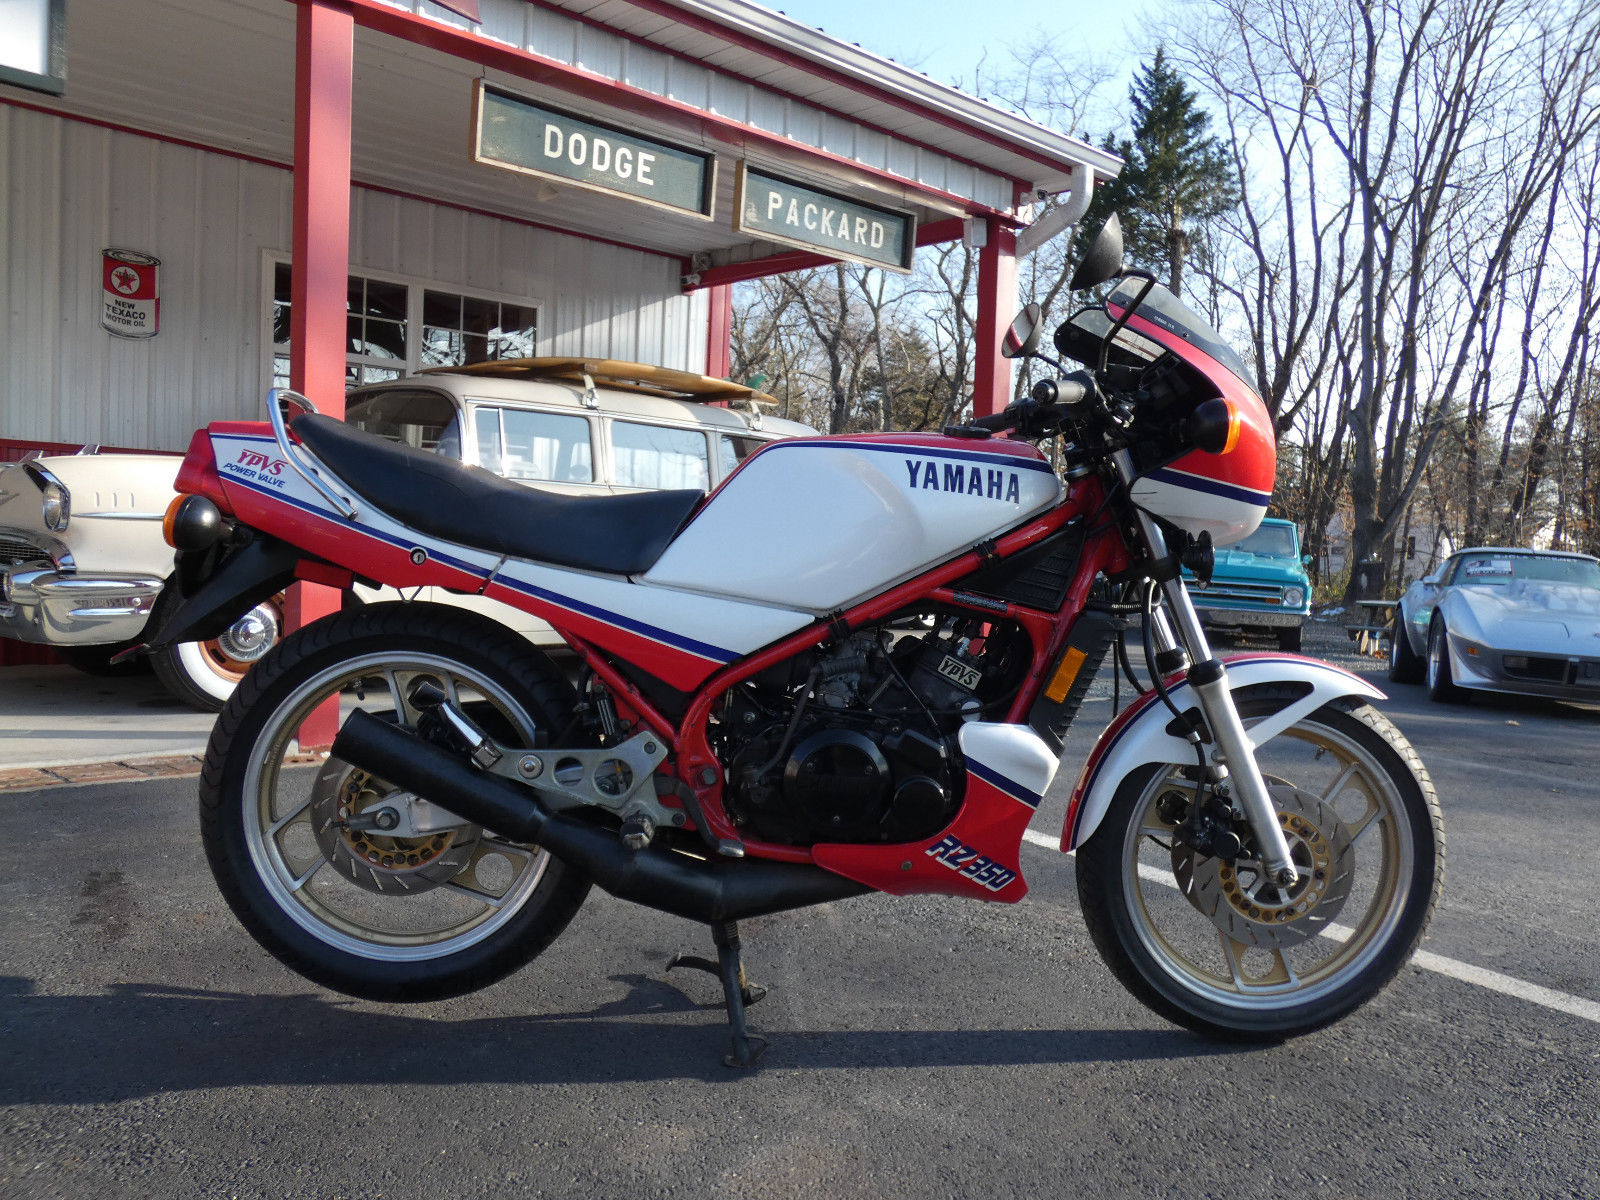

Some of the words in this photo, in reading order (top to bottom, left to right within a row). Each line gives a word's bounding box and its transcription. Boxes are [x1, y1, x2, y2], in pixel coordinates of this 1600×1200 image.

[544, 123, 656, 186] DODGE
[767, 191, 884, 249] PACKARD
[105, 303, 145, 320] TEXACO
[115, 299, 135, 309] NEW
[105, 312, 132, 326] MOTOR
[133, 319, 146, 328] OIL
[223, 462, 257, 479] POWER
[257, 473, 286, 489] VALVE
[237, 448, 289, 476] YPVS
[905, 459, 1020, 505] YAMAHA
[940, 657, 979, 685] YPVS
